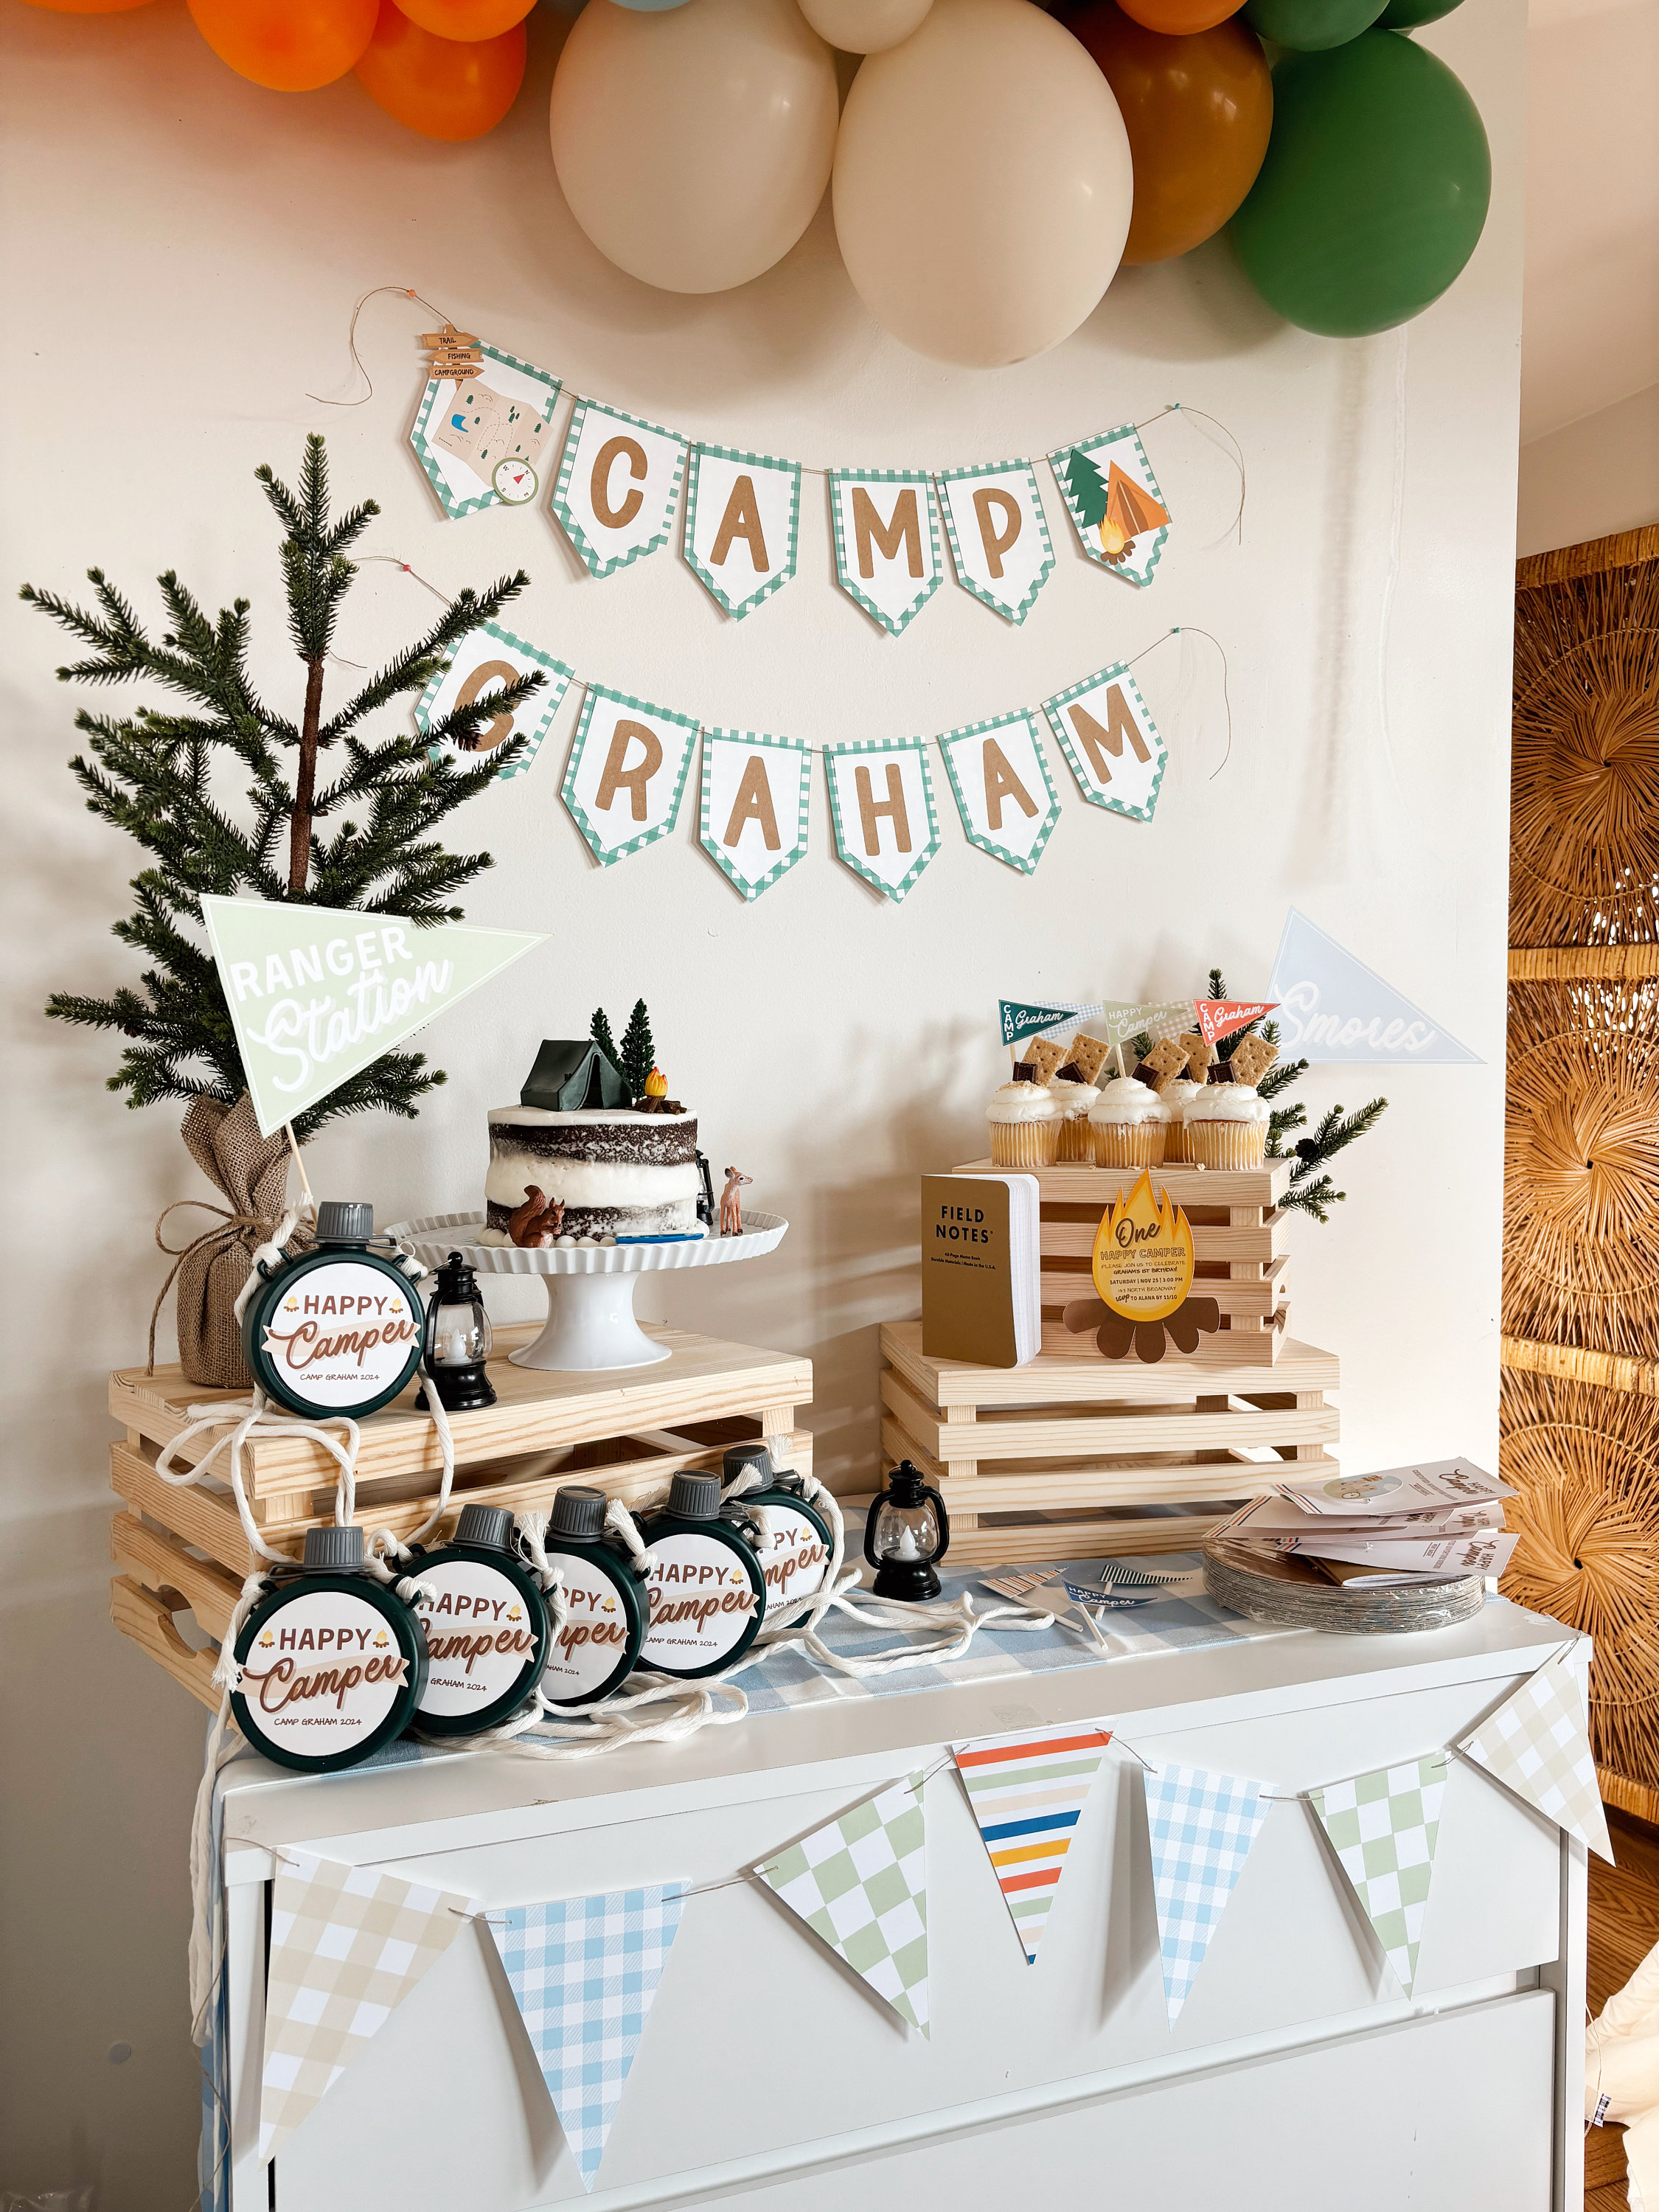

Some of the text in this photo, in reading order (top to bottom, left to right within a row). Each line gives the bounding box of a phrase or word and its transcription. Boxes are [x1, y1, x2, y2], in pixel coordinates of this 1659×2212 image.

[591, 436, 1022, 580] CAMP
[229, 927, 413, 1001] RANGER
[1003, 1004, 1064, 1041] CAMP Graham
[1108, 1007, 1142, 1020] HAPPY
[1109, 1011, 1167, 1037] Camper
[1199, 1003, 1265, 1041] CAMP Graham
[1274, 981, 1436, 1051] Smores
[246, 959, 453, 1093] Station
[941, 1205, 984, 1223] FIELD
[1115, 1217, 1161, 1248] One
[1100, 1247, 1186, 1261] HAPPY CAMPER
[304, 1295, 389, 1315] HAPPY
[268, 1319, 415, 1369] Camper
[325, 1373, 358, 1381] GRAHAM
[1455, 1540, 1500, 1567] Camper
[1475, 1553, 1495, 1571] HAPPY
[649, 1562, 729, 1585] HAPPY
[764, 1544, 824, 1595] mper
[1069, 1586, 1107, 1599] HAPPY
[1069, 1591, 1136, 1607] Camper
[765, 1601, 785, 1610] AHAM
[279, 1627, 372, 1651] HAPPY
[420, 1617, 532, 1674] amper
[546, 1664, 563, 1672] AHAM
[243, 1654, 403, 1714] Camper
[430, 1677, 487, 1691] GRAHAM 2024
[274, 1717, 363, 1727] CAMP GRAHAM 2024
